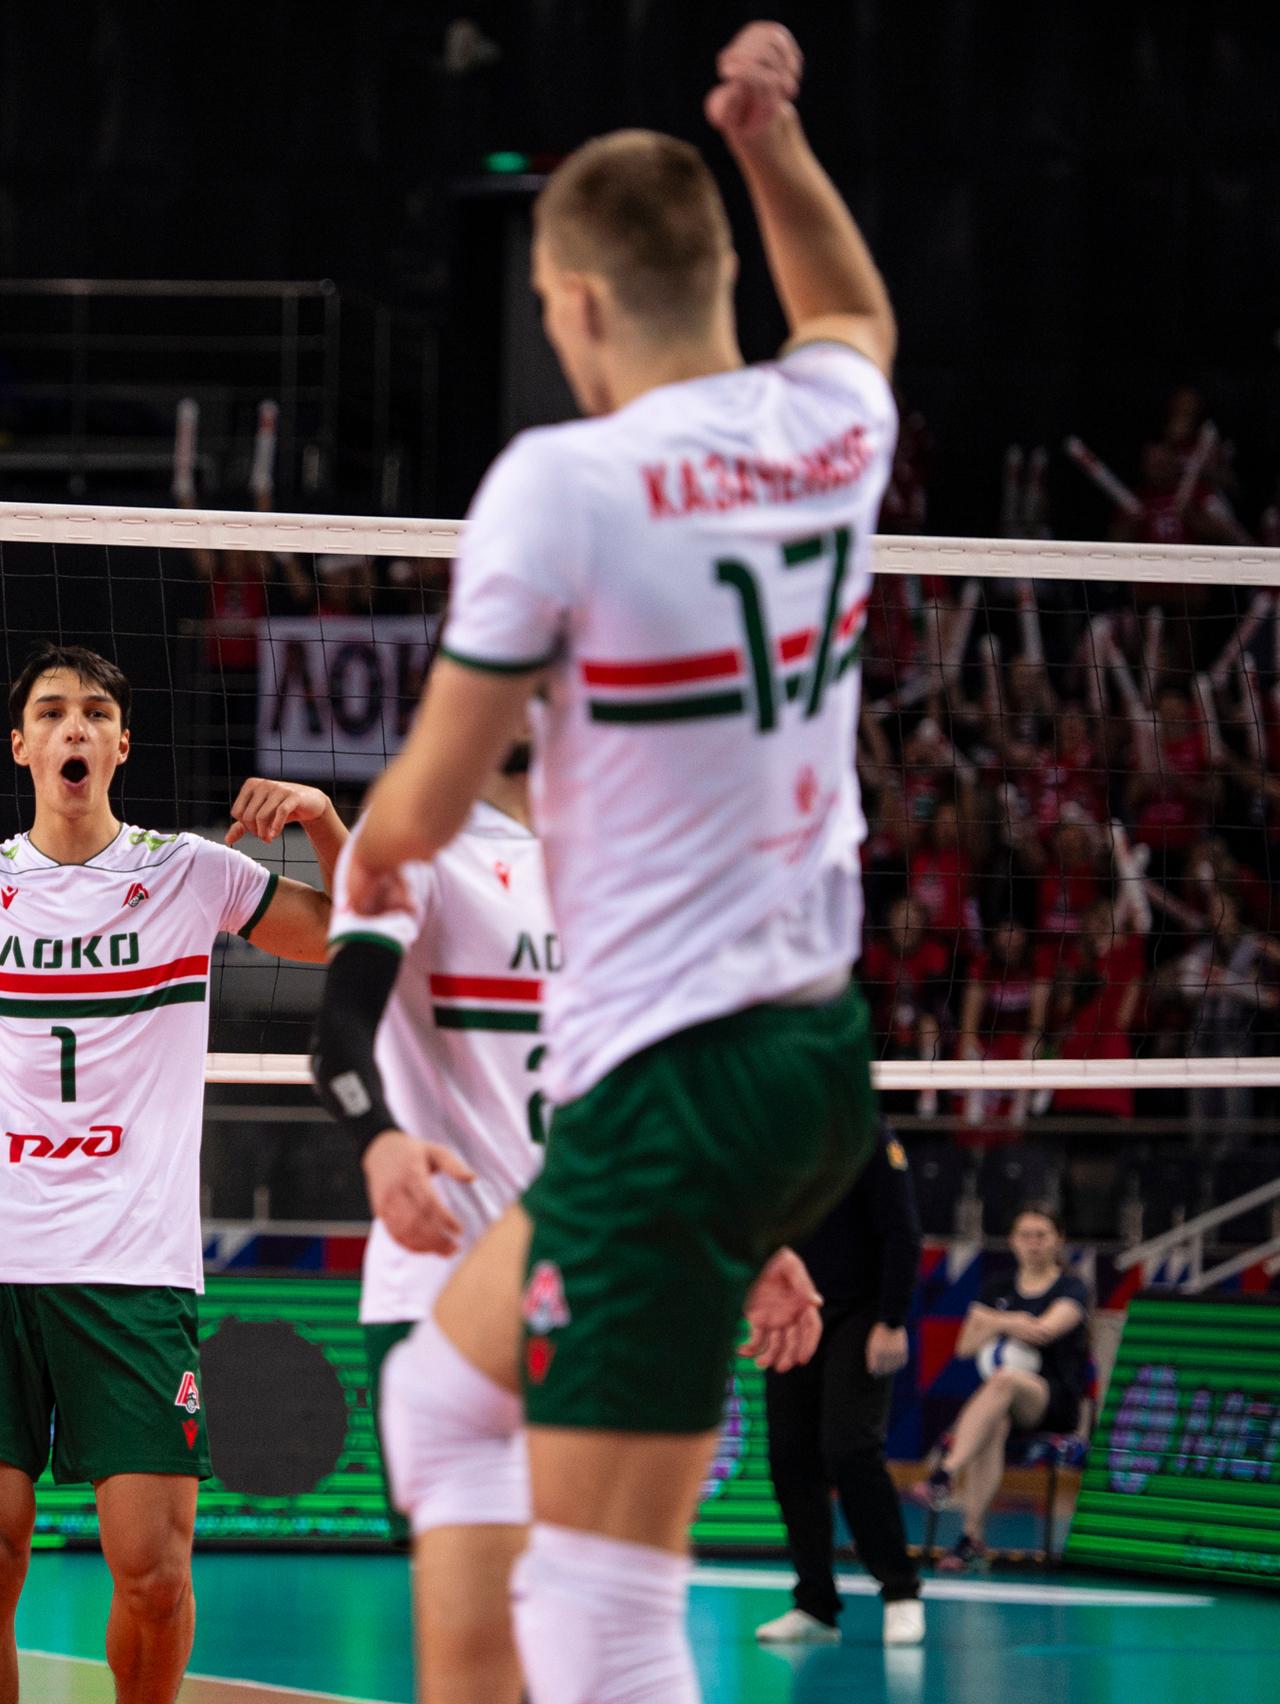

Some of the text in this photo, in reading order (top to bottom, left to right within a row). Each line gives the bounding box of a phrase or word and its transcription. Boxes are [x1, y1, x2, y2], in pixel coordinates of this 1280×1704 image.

[714, 527, 851, 734] 17
[509, 930, 566, 973] ЛО
[51, 1026, 77, 1103] 1
